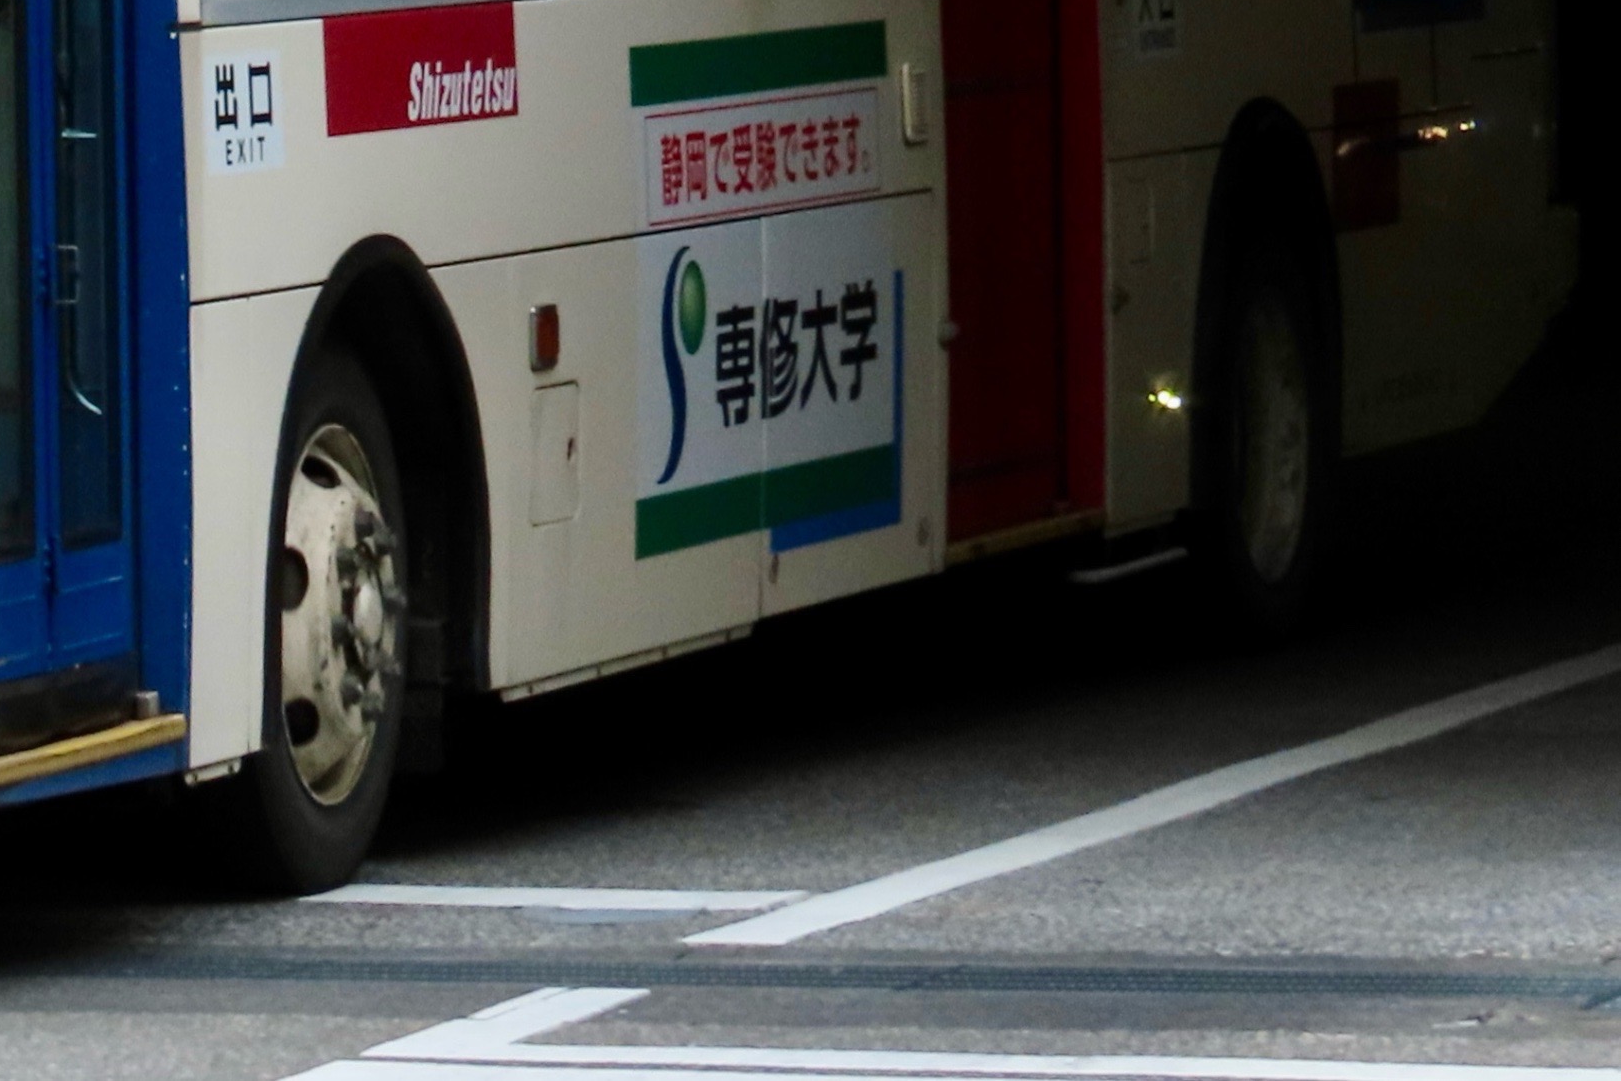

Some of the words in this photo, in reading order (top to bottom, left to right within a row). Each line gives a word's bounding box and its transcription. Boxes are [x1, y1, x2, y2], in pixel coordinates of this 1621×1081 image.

[214, 62, 273, 132] 出口
[408, 58, 516, 122] Shizutetsu
[225, 135, 266, 166] EXIT
[660, 113, 870, 206] 静岡で受験できます。
[715, 279, 878, 428] 専修大学
